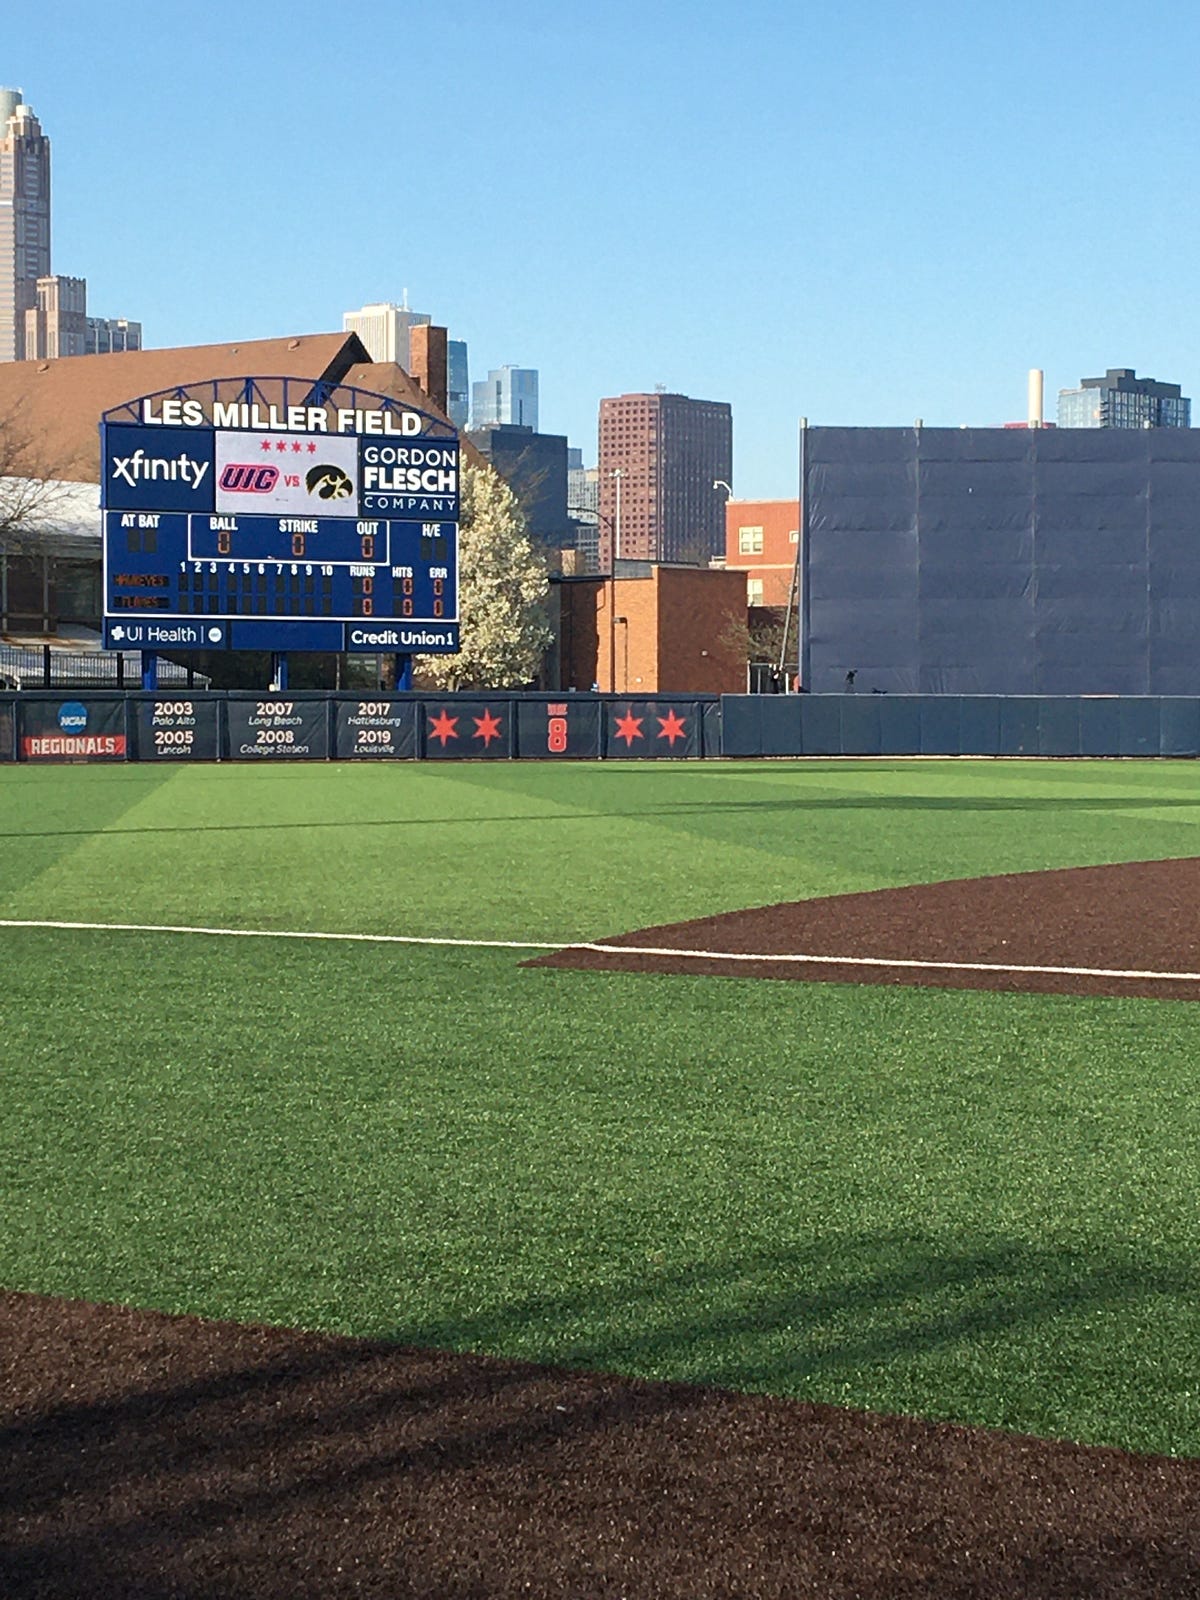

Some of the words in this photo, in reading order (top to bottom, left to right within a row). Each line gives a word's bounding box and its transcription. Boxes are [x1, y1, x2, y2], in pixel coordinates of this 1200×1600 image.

[143, 399, 204, 427] LES
[213, 402, 328, 432] MILLER
[337, 408, 422, 437] FIELD
[364, 446, 456, 467] GORDON
[112, 449, 209, 489] xfinity
[220, 465, 279, 491] UIC
[284, 475, 300, 487] VS
[364, 466, 456, 492] FLESCH
[364, 496, 456, 511] COMPANY
[121, 514, 136, 527] AT
[138, 515, 160, 528] BAT
[209, 517, 238, 530] BALL
[279, 519, 318, 533] STRIKE
[356, 522, 379, 535] OUT
[422, 524, 441, 537] H/E
[218, 531, 230, 554] 0
[292, 533, 304, 556] 0
[362, 535, 374, 558] 0
[180, 561, 186, 572] 1
[194, 563, 202, 573] 2
[209, 562, 217, 573] 3
[228, 563, 235, 574] 4
[243, 564, 250, 574] 5
[257, 563, 265, 575] 6
[276, 564, 283, 575] 7
[291, 564, 298, 575] 8
[305, 564, 313, 576] 9
[321, 565, 333, 576] 10
[350, 565, 375, 577] RUNS
[392, 566, 413, 578] HITS
[429, 567, 448, 579] ERR
[362, 577, 372, 595] 0
[403, 578, 413, 595] 0
[433, 578, 443, 596] 0
[362, 598, 372, 616] 0
[403, 598, 413, 616] 0
[433, 599, 443, 617] 0
[126, 626, 143, 641] UI
[148, 626, 197, 642] Health
[351, 630, 398, 645] Credit
[154, 702, 193, 715] 2003
[256, 702, 294, 715] 2007
[358, 702, 391, 715] 2017
[60, 715, 86, 726] NCAA
[152, 716, 173, 726] Palo
[176, 716, 196, 726] Alto
[248, 716, 272, 727] Long
[273, 716, 303, 726] Beach
[154, 731, 194, 744] 2005
[256, 730, 294, 743] 2008
[358, 730, 391, 743] 2019
[547, 717, 567, 753] 8
[31, 737, 115, 755] REGIONALS
[157, 745, 192, 755] Lincoln
[240, 744, 275, 755] College
[276, 744, 309, 754] Station
[353, 744, 395, 754] Louisville
